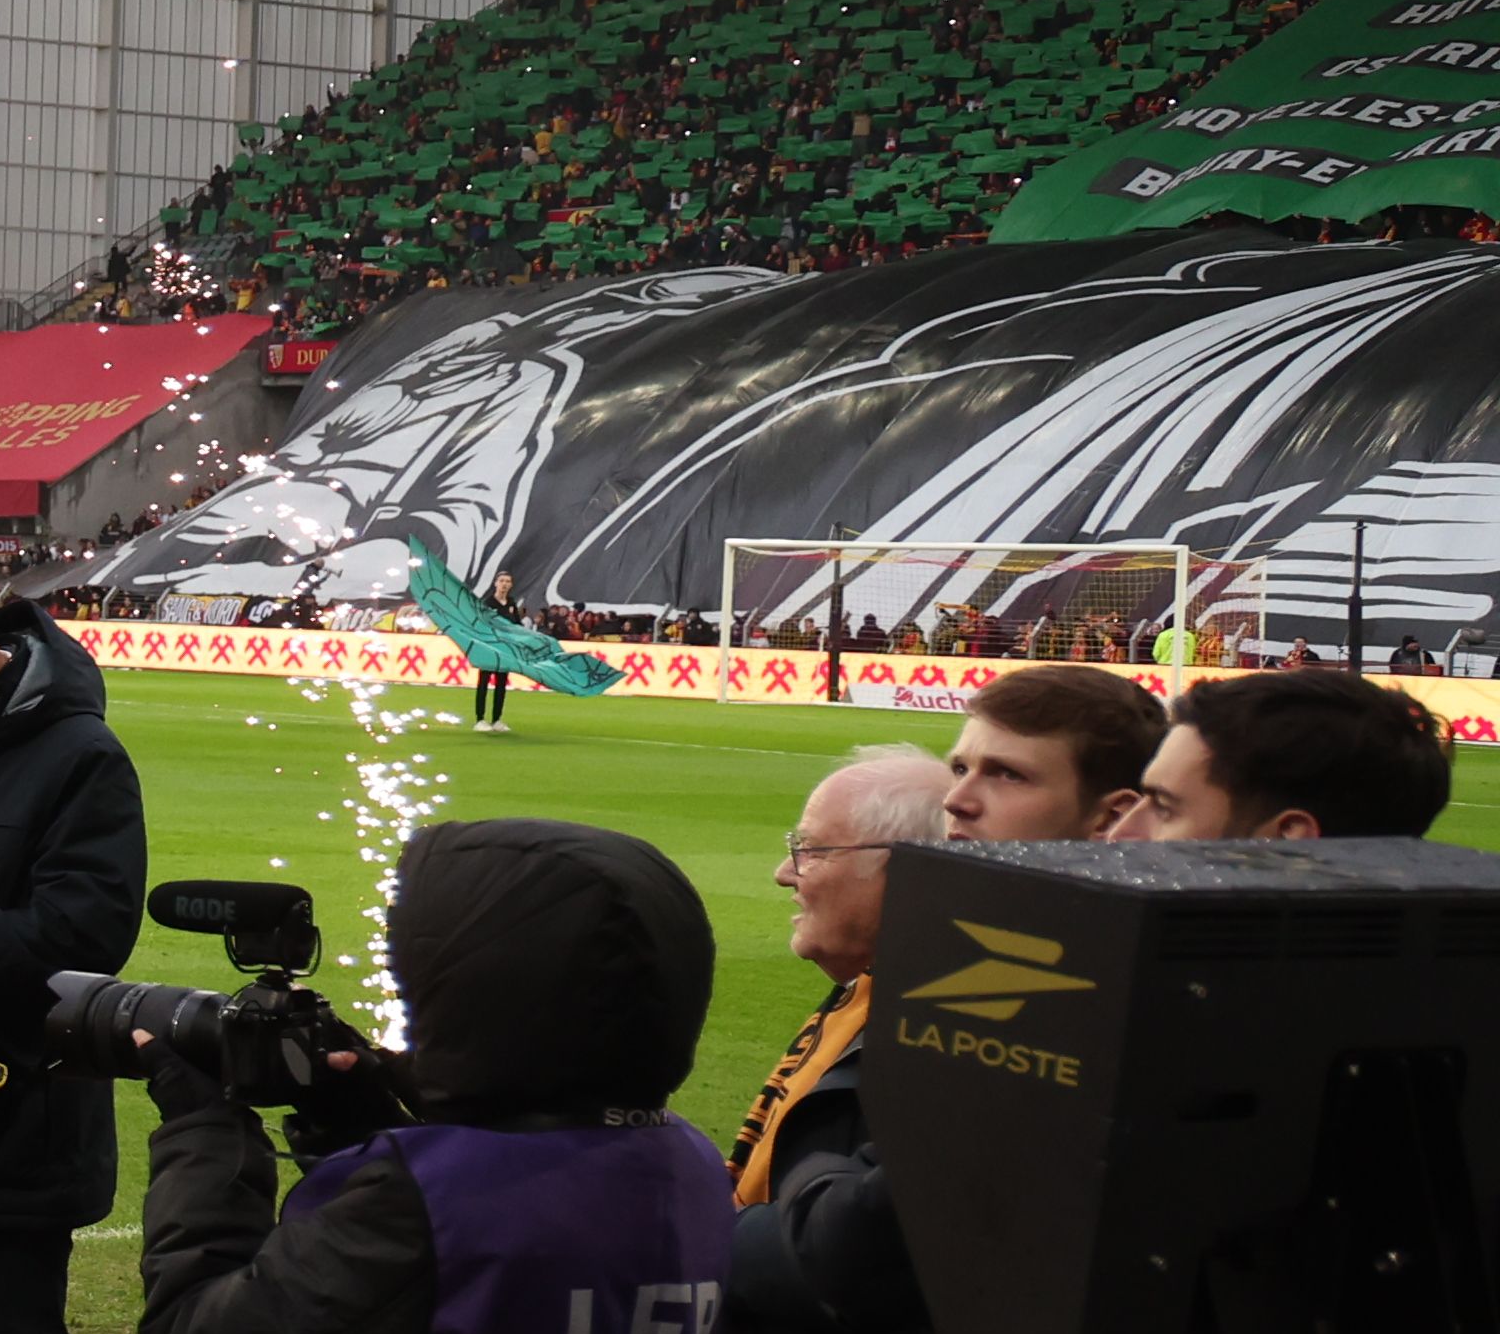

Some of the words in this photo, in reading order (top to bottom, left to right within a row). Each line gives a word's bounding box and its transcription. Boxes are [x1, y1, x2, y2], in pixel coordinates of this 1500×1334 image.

[1322, 42, 1500, 78] OSTRI
[896, 1018, 945, 1053] LA
[952, 1030, 1081, 1087] POSTE
